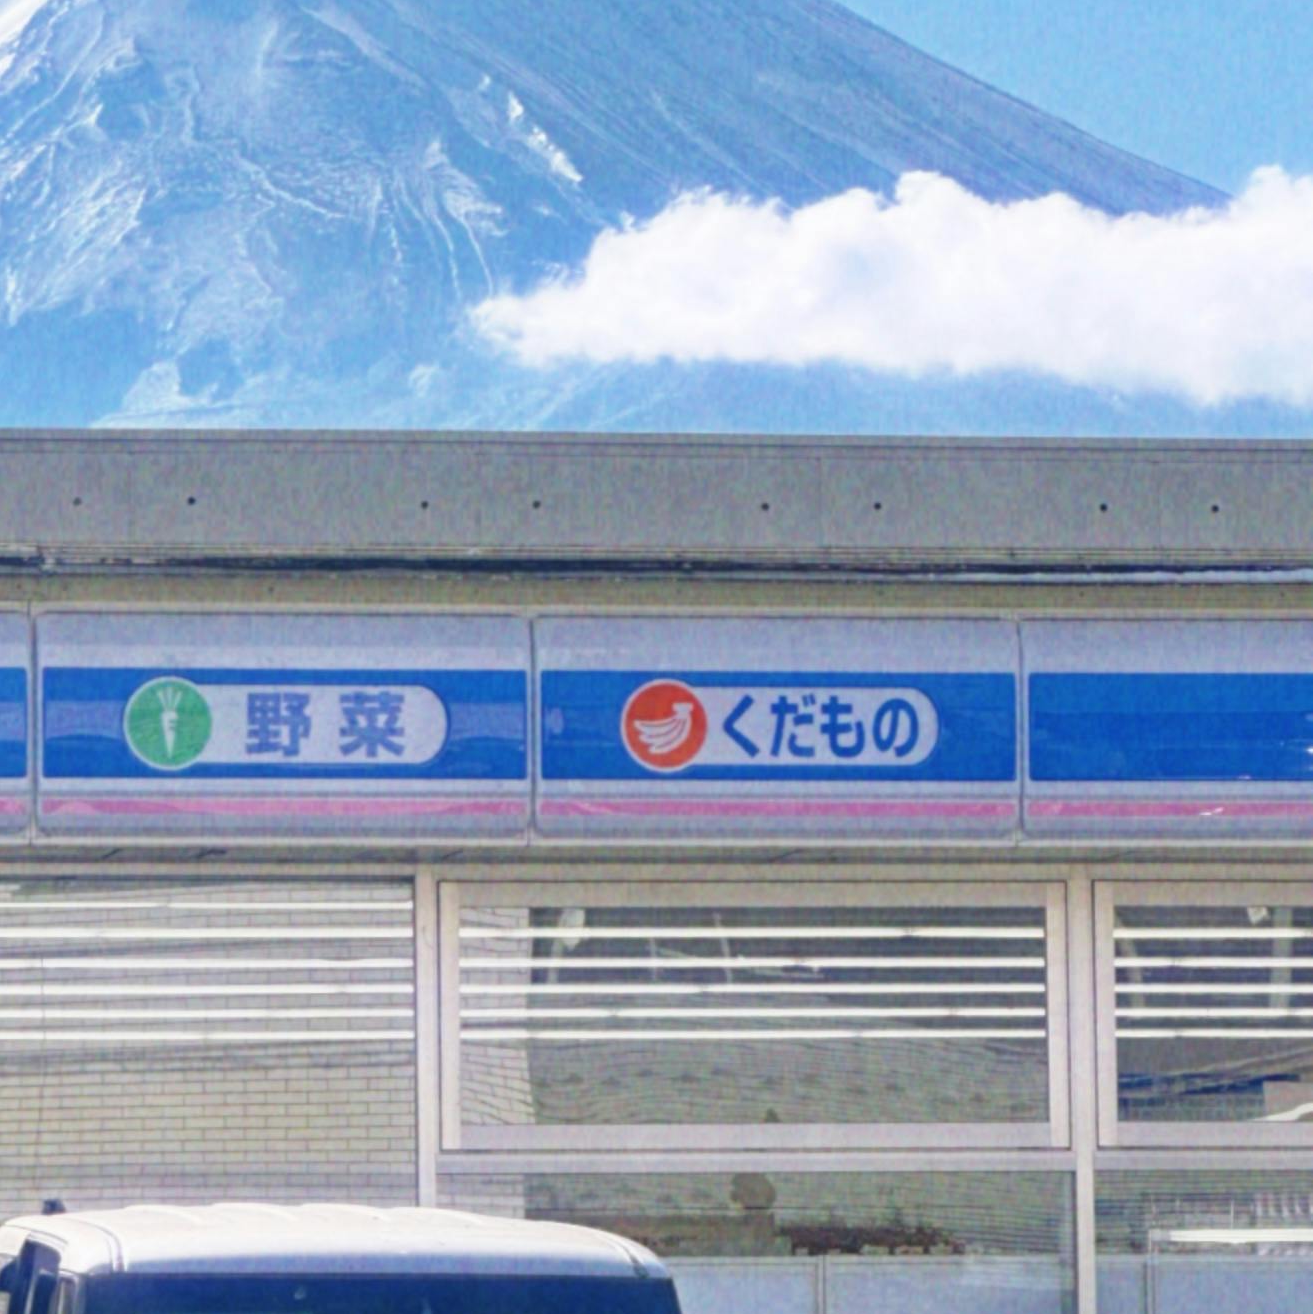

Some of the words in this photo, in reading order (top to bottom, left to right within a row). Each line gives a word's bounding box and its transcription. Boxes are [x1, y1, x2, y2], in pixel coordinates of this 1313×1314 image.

[245, 690, 406, 759] 野菜
[721, 694, 920, 758] くだもの
